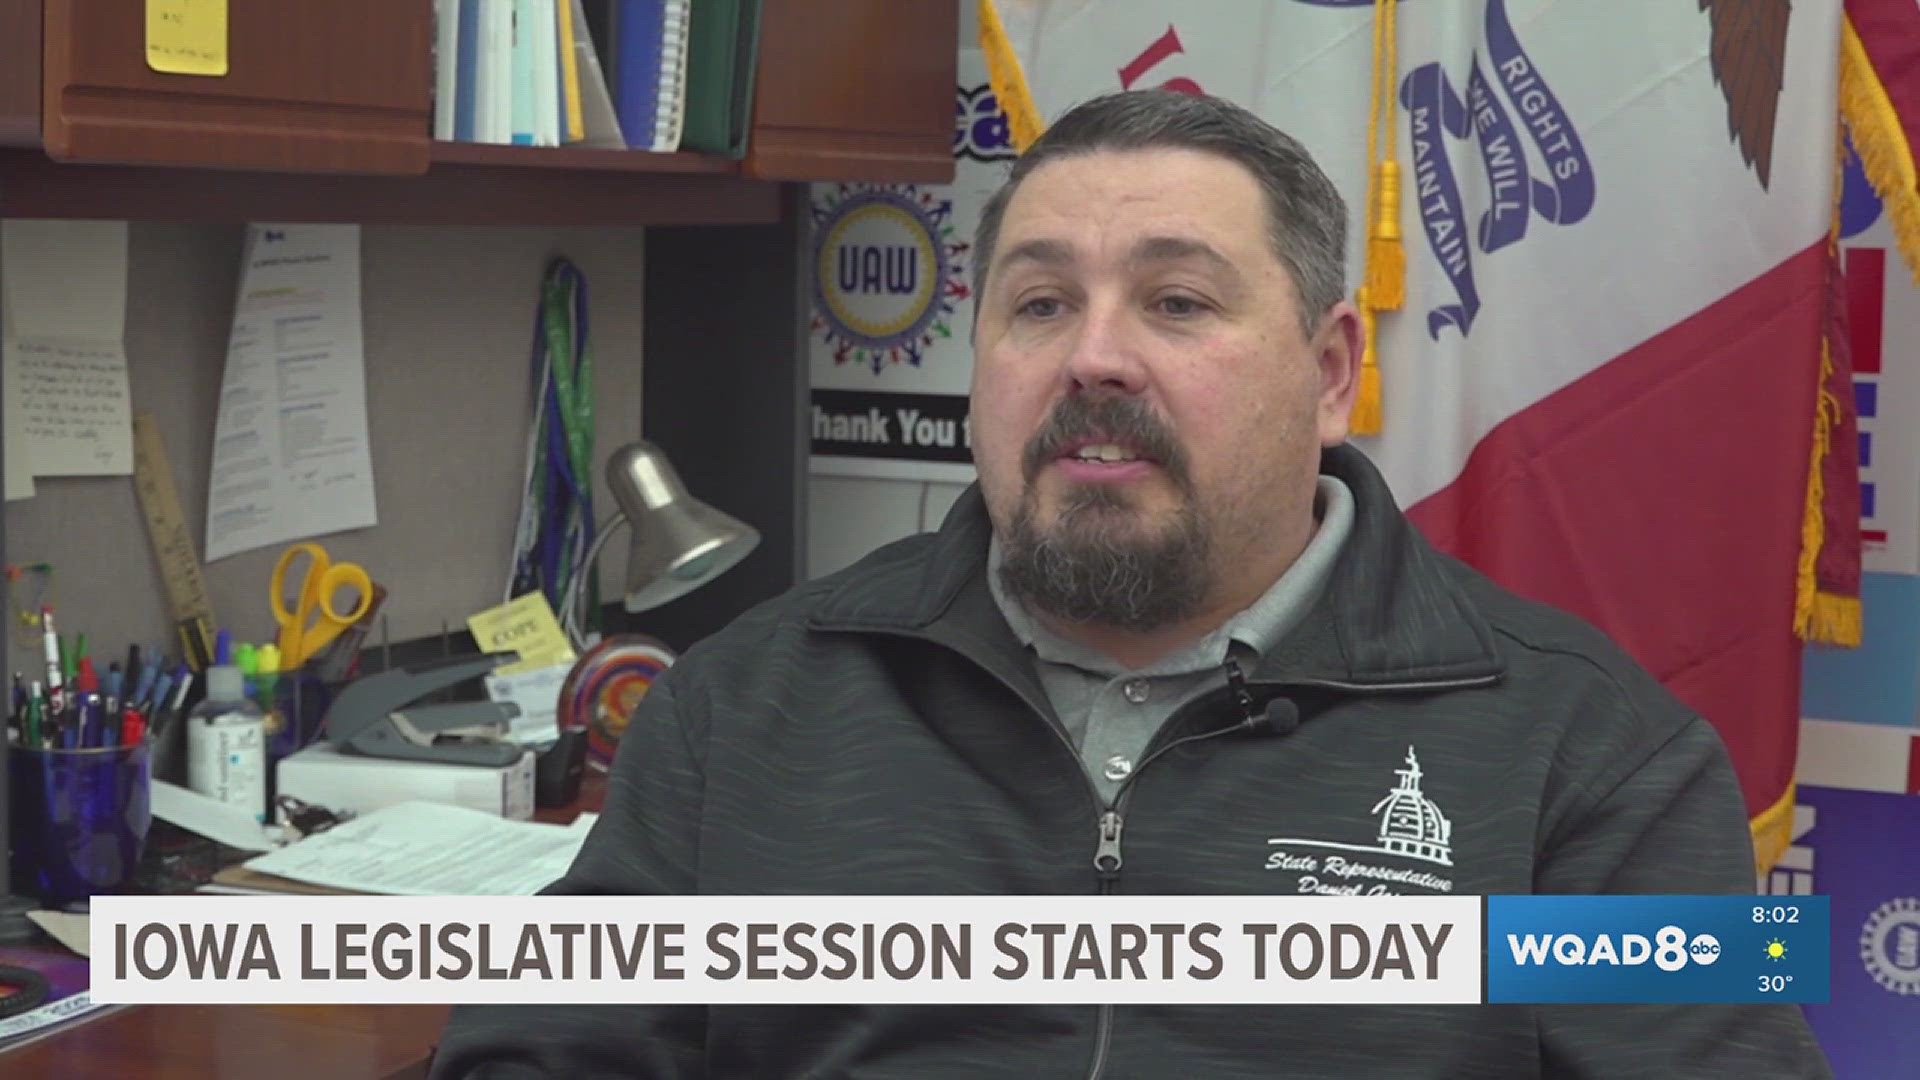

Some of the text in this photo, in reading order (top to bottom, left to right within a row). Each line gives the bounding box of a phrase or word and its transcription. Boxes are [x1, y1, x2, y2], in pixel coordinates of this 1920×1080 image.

[1470, 78, 1520, 220] WE WILL
[1501, 55, 1580, 180] RIGHTS
[1411, 107, 1467, 276] MAINTAIN
[839, 245, 917, 295] UAW
[812, 404, 891, 444] hank
[897, 408, 956, 448] You
[1265, 852, 1317, 871] State
[1322, 856, 1453, 893] Representative
